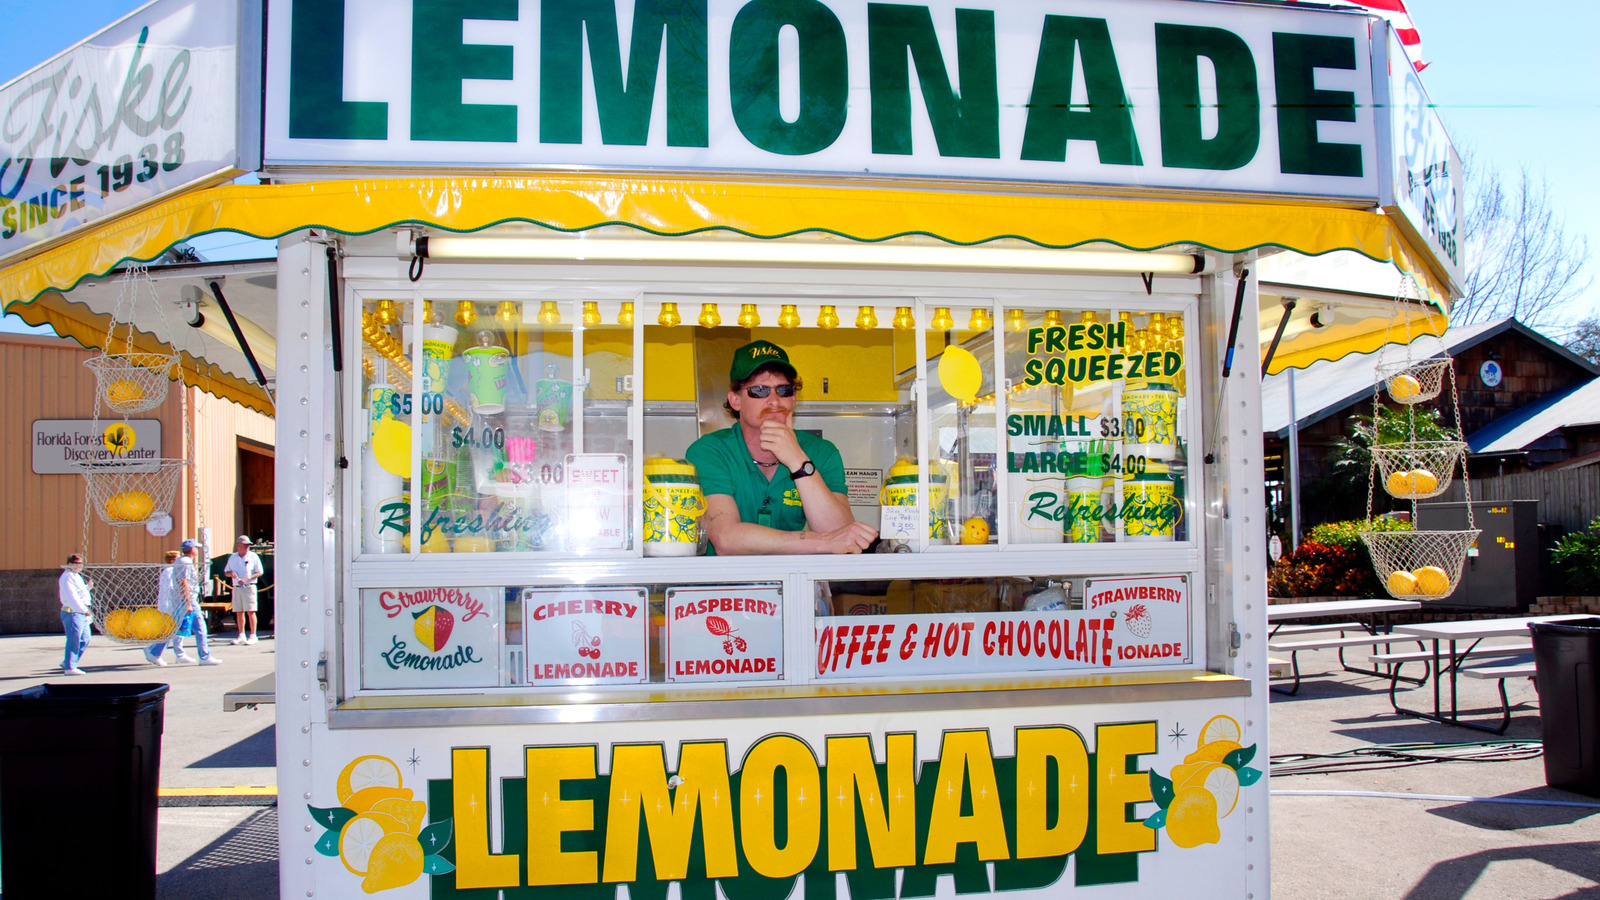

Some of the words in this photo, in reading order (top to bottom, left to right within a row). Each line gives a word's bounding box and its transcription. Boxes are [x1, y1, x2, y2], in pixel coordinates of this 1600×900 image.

[288, 0, 1364, 179] LEMONADE
[1, 25, 193, 200] Fiske
[2, 175, 86, 240] SINCE
[96, 132, 186, 200] 1938
[1027, 320, 1126, 354] FRESH
[1023, 351, 1183, 387] SQUEEZED
[452, 426, 505, 449] $4.00
[1007, 414, 1091, 437] SMALL
[1099, 417, 1145, 438] $3.00
[37, 432, 72, 446] Florida
[511, 461, 564, 485] $3.00
[1007, 451, 1088, 474] LARGE
[1100, 452, 1146, 475] $4.00
[572, 469, 619, 483] SWEET
[1027, 491, 1175, 530] Refreshing
[377, 502, 552, 546] Rfreshing
[379, 587, 490, 622] Strawberry
[532, 599, 639, 621] CHERRY
[674, 598, 778, 621] RASPBERRY
[1091, 586, 1182, 610] STRAWBERRY
[381, 634, 483, 671] Lemonade
[815, 624, 896, 675] OFFEE
[899, 623, 918, 660] &
[922, 621, 975, 659] HOT
[983, 618, 1115, 667] CHOCOLATE
[1117, 642, 1182, 660] ONADE
[534, 661, 639, 679] LEMONADE
[675, 657, 777, 676] LEMONADE
[450, 719, 1160, 891] LEMONADE
